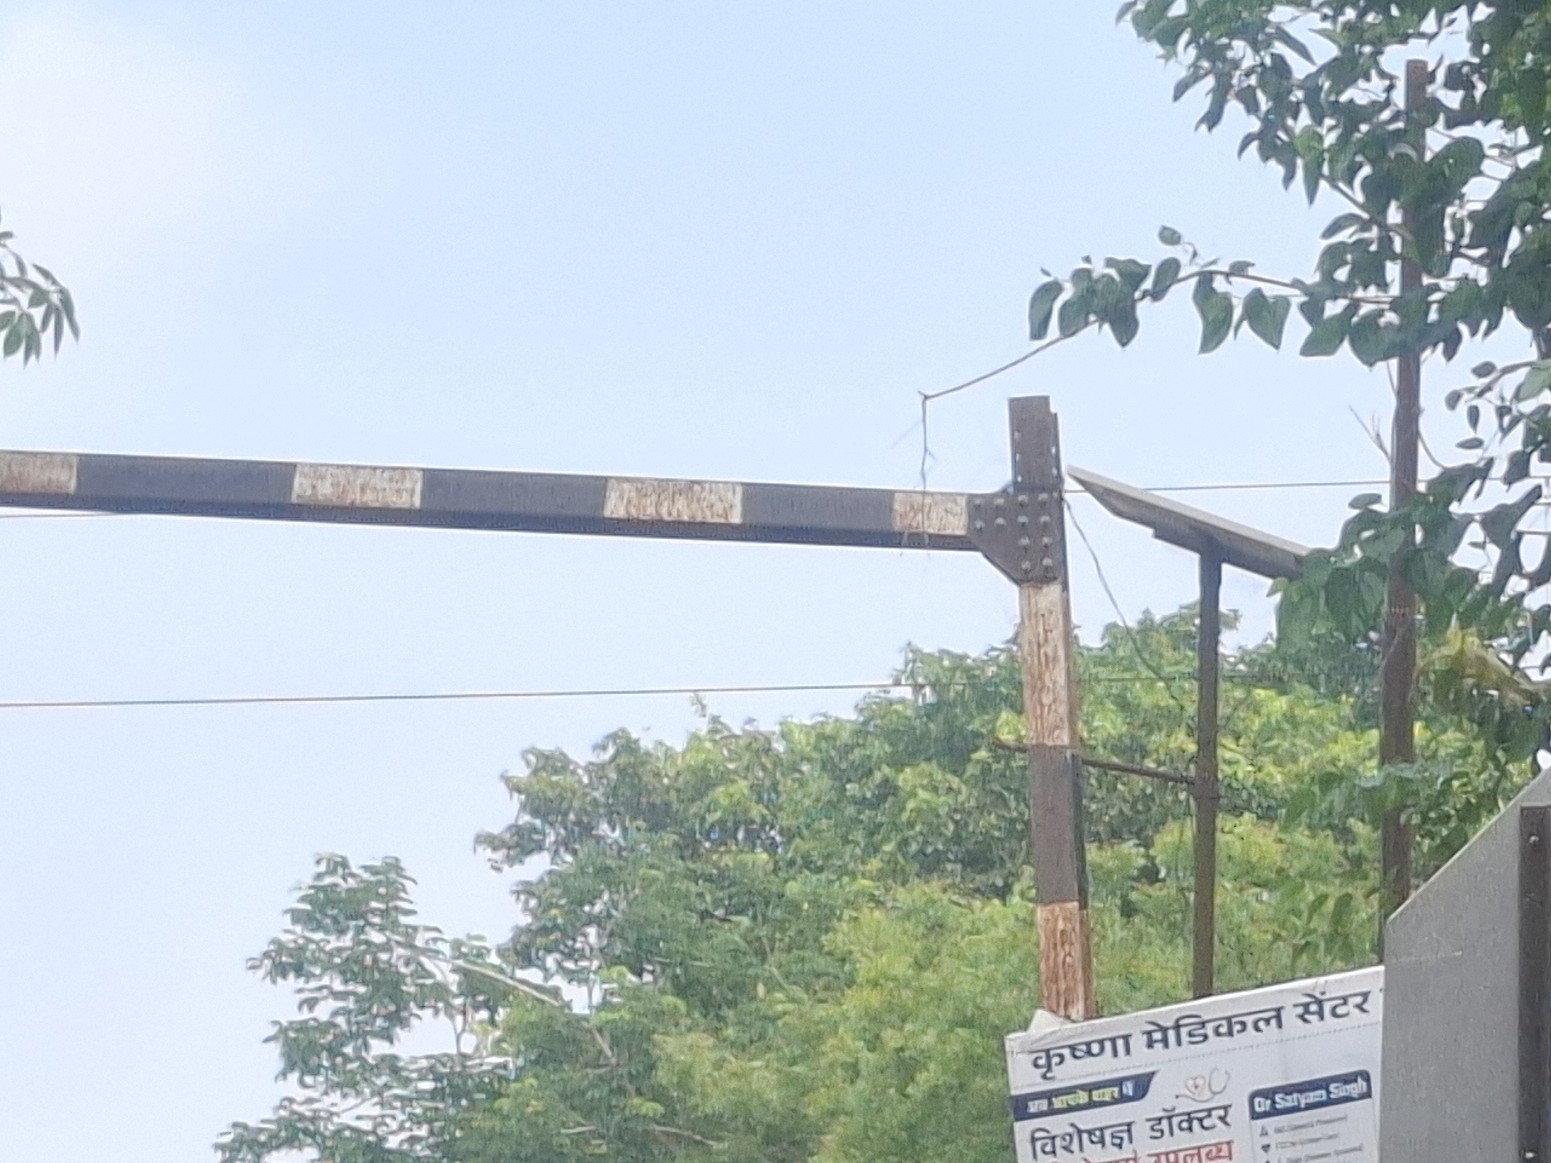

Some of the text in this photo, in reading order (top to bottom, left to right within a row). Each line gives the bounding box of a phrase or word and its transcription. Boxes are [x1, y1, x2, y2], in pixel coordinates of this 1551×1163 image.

[1029, 989, 1373, 1080] कृष्णा मेडिकल सेंटर
[1030, 1121, 1136, 1161] विशेषज्ञ
[1146, 1103, 1233, 1140] डॉक्टर
